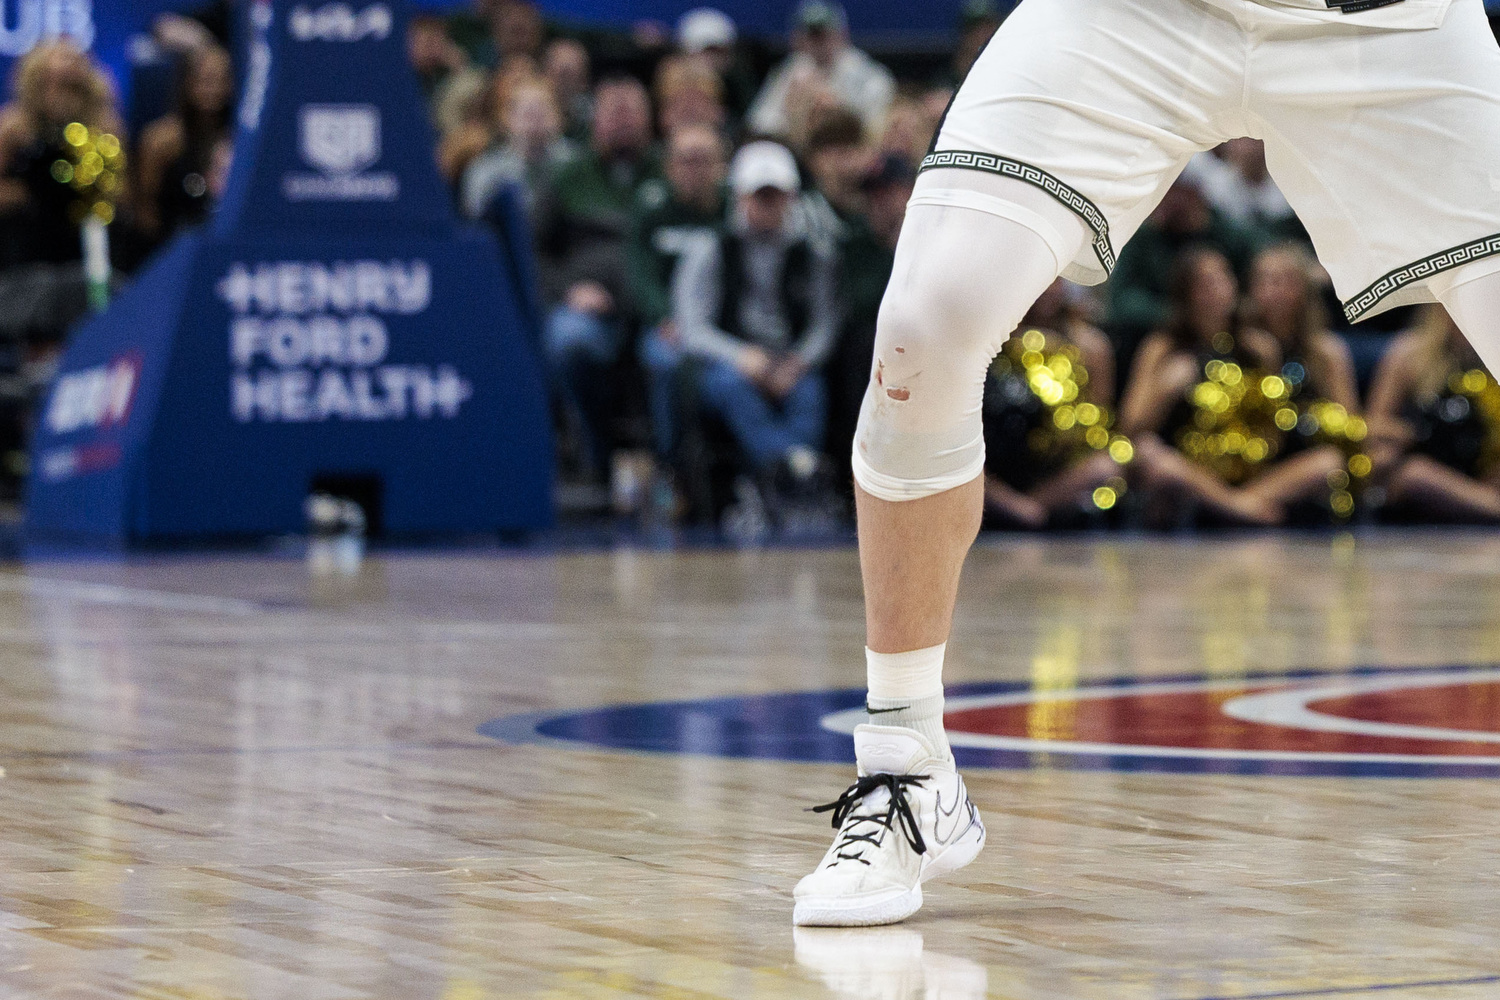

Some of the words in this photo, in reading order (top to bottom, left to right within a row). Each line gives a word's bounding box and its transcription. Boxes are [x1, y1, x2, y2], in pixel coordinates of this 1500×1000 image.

[220, 260, 432, 314] HENRY
[229, 315, 390, 366] FORD
[230, 365, 468, 422] HEALTH
